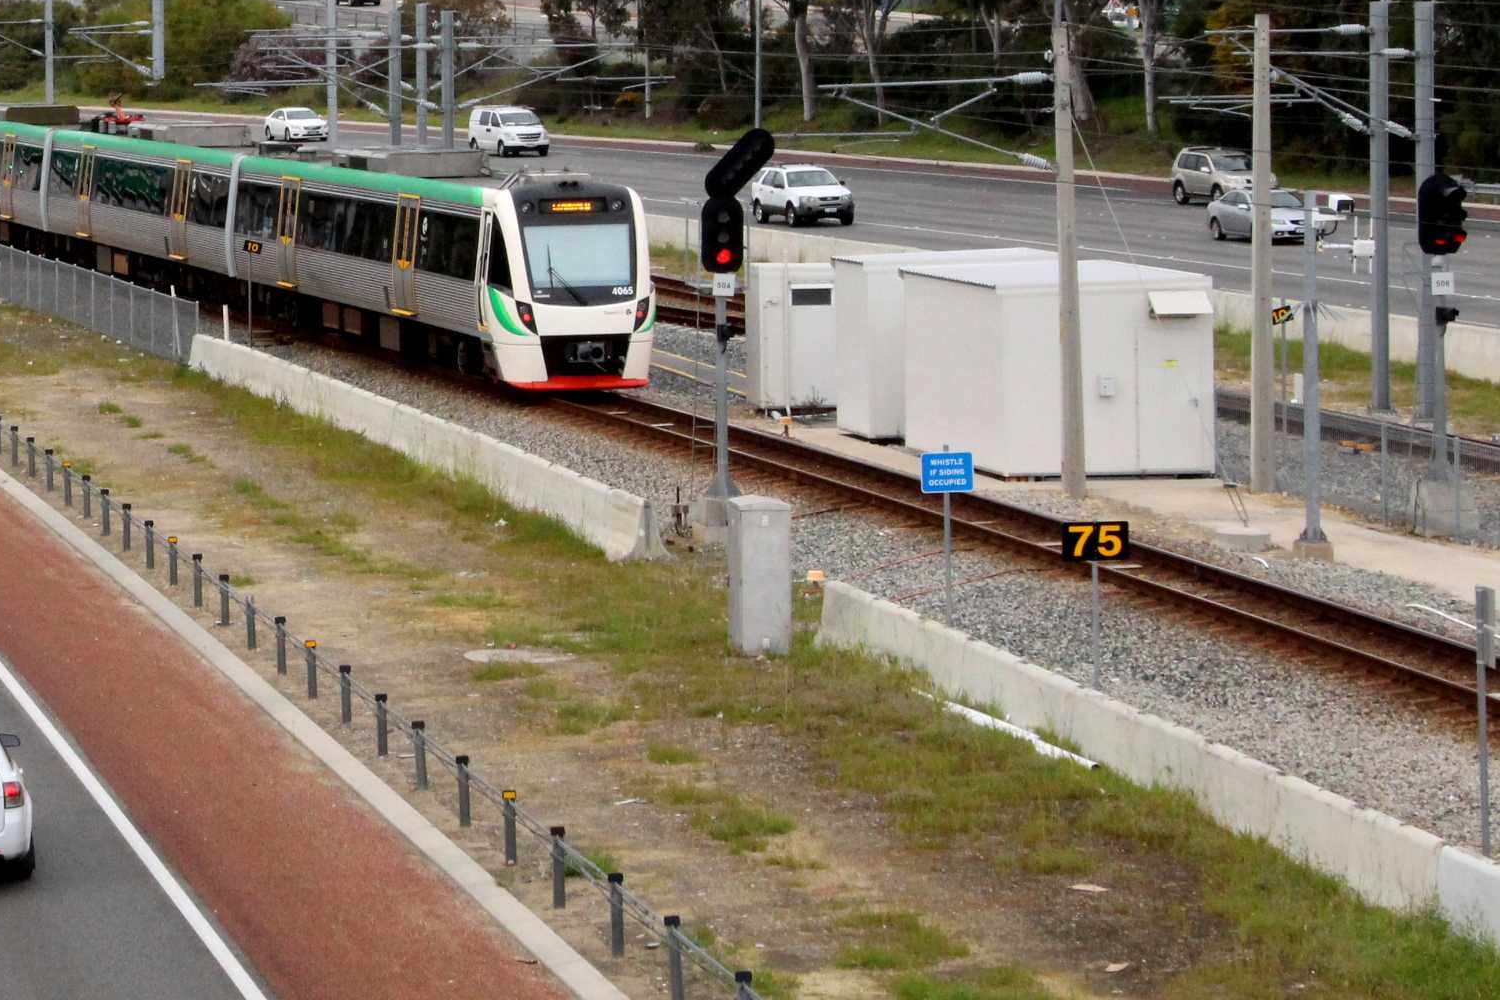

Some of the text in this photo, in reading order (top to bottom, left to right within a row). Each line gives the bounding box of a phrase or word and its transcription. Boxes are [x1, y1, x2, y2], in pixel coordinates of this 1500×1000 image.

[247, 242, 259, 252] 10
[611, 286, 634, 295] 4065
[930, 458, 965, 466] WHISTLE
[939, 468, 965, 476] SIDING
[928, 478, 967, 487] OCCUPIED
[1067, 524, 1123, 557] 75
